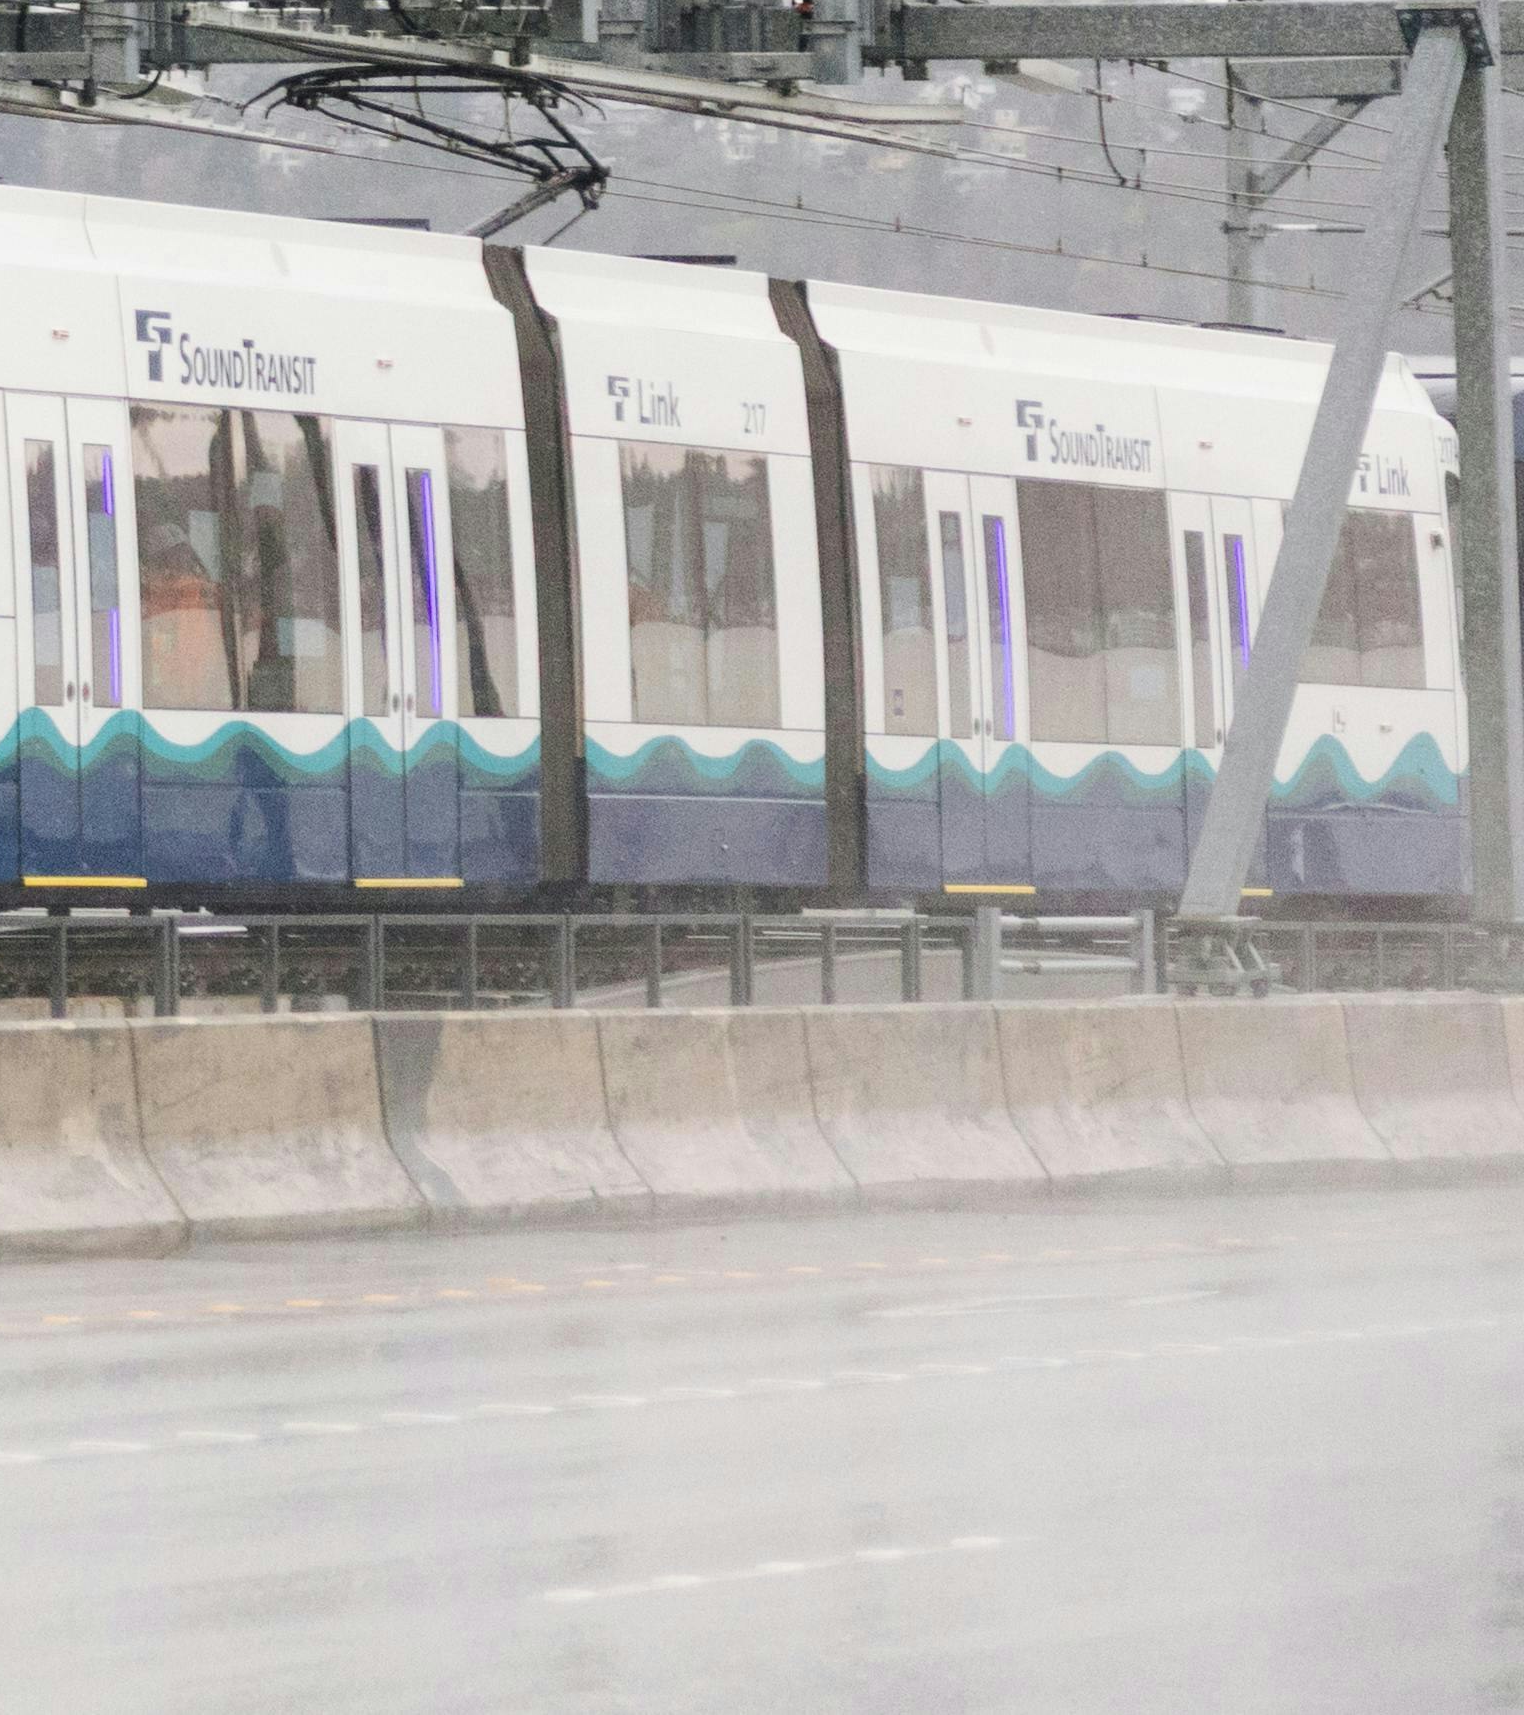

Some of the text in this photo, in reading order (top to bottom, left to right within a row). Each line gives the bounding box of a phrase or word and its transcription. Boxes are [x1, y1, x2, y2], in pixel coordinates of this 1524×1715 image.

[637, 378, 681, 427] Link
[742, 401, 766, 435] 217
[1376, 453, 1411, 497] Link
